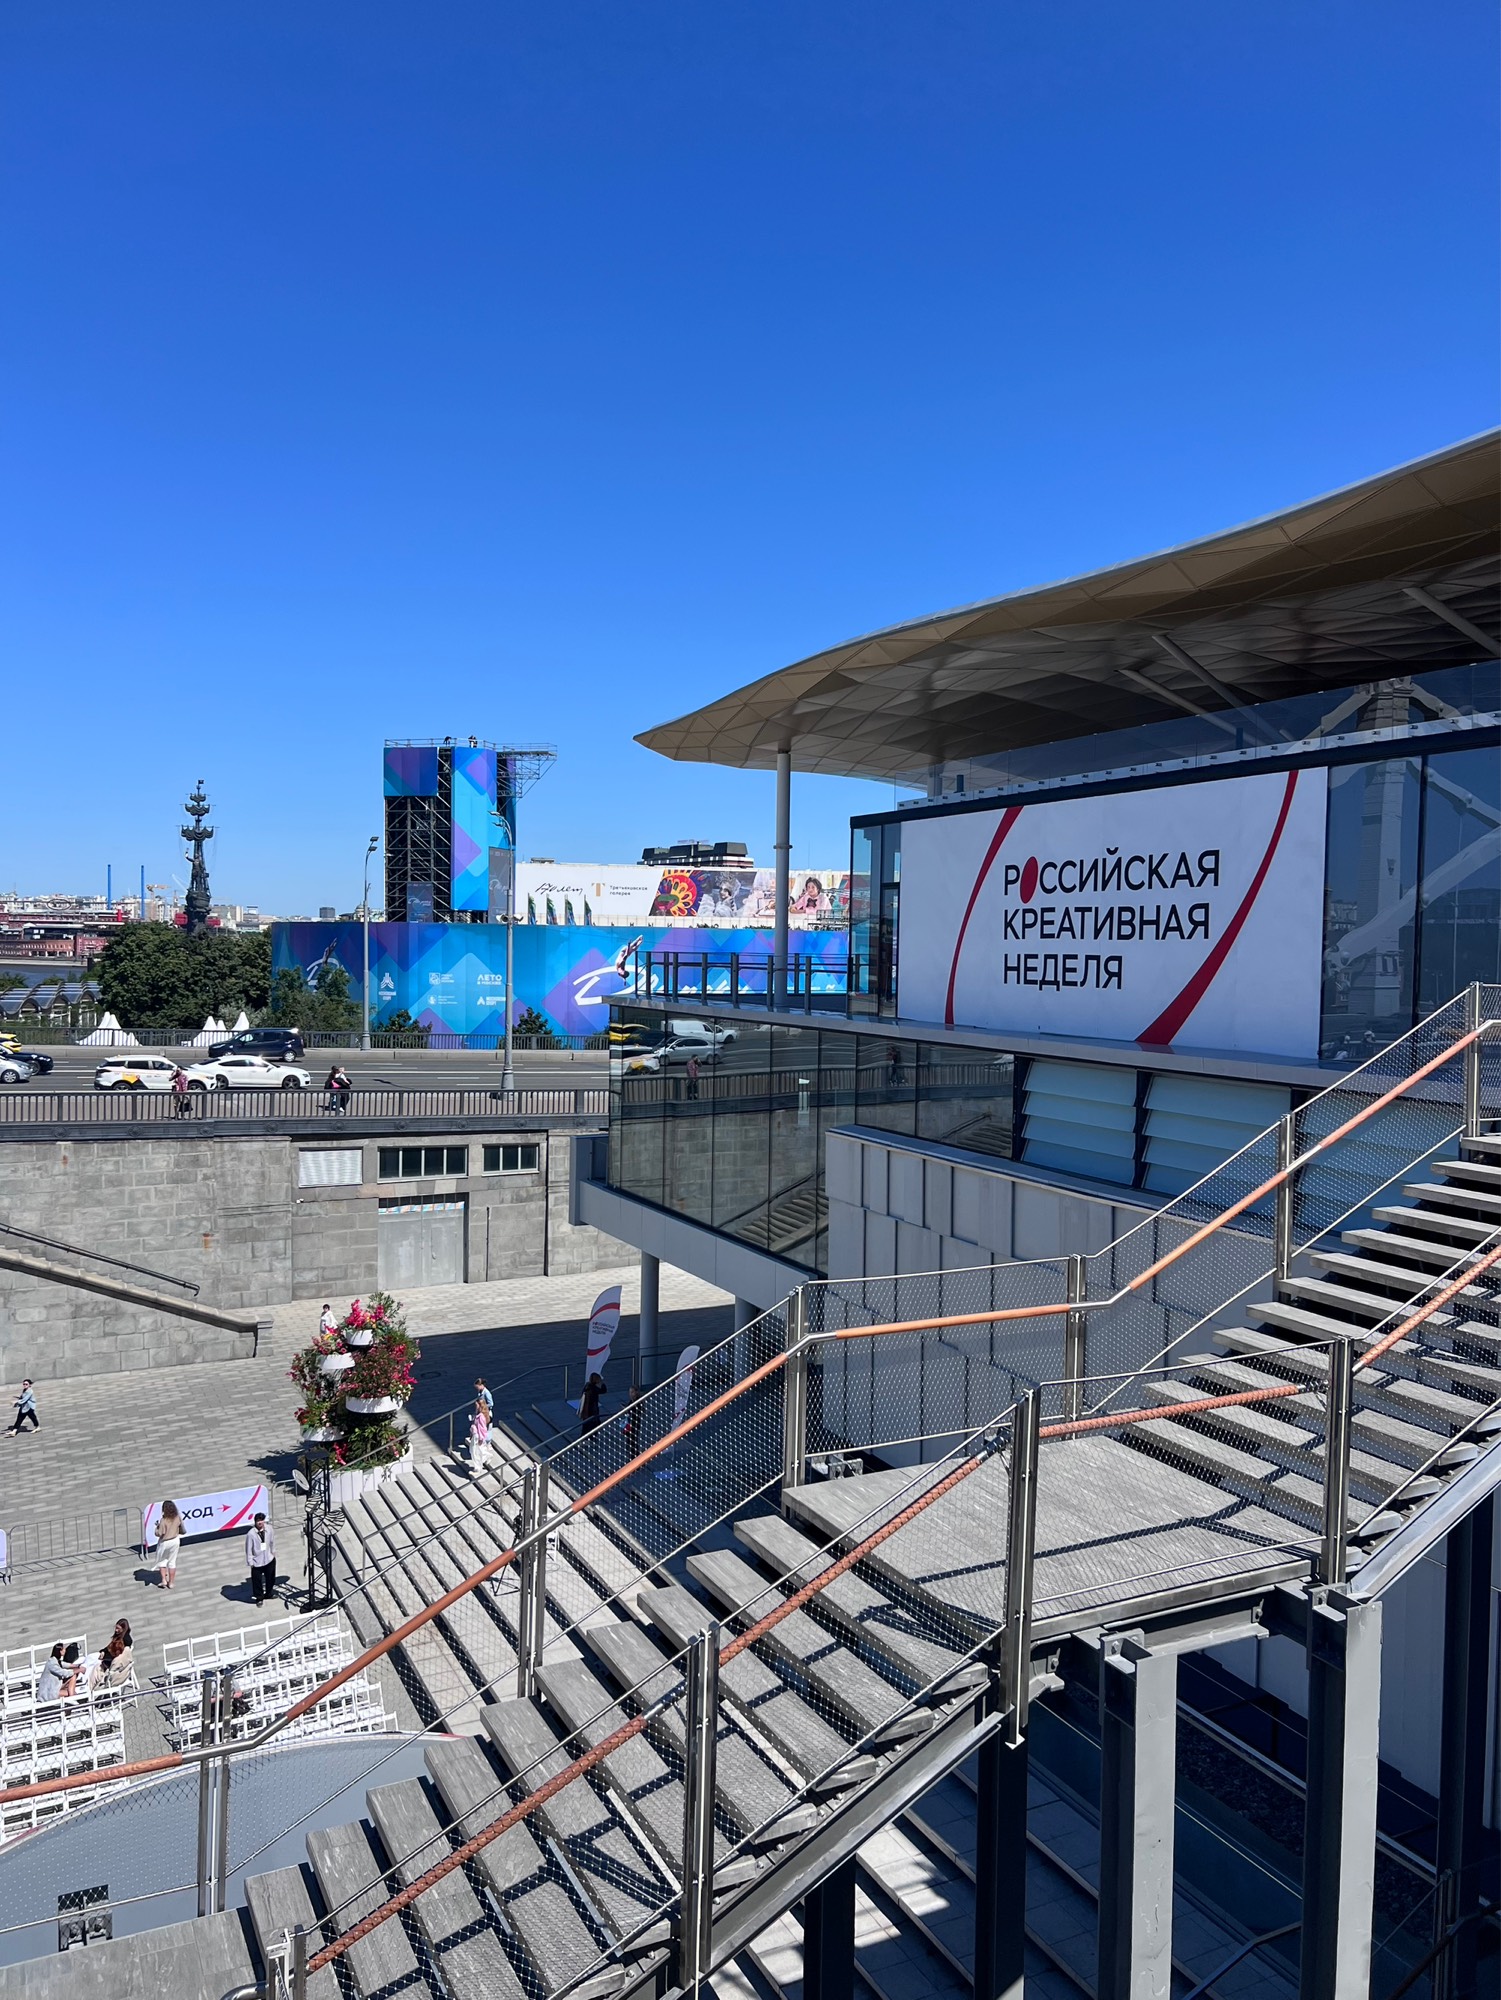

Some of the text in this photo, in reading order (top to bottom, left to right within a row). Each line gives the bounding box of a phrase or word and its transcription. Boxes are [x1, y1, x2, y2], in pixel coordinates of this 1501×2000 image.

[1003, 847, 1220, 904] РОССИЙСКАЯ
[1003, 902, 1210, 941] КРЕАТИВНАЯ
[1003, 953, 1123, 991] НЕДЕЛЯ
[181, 1505, 214, 1521] ХОД
